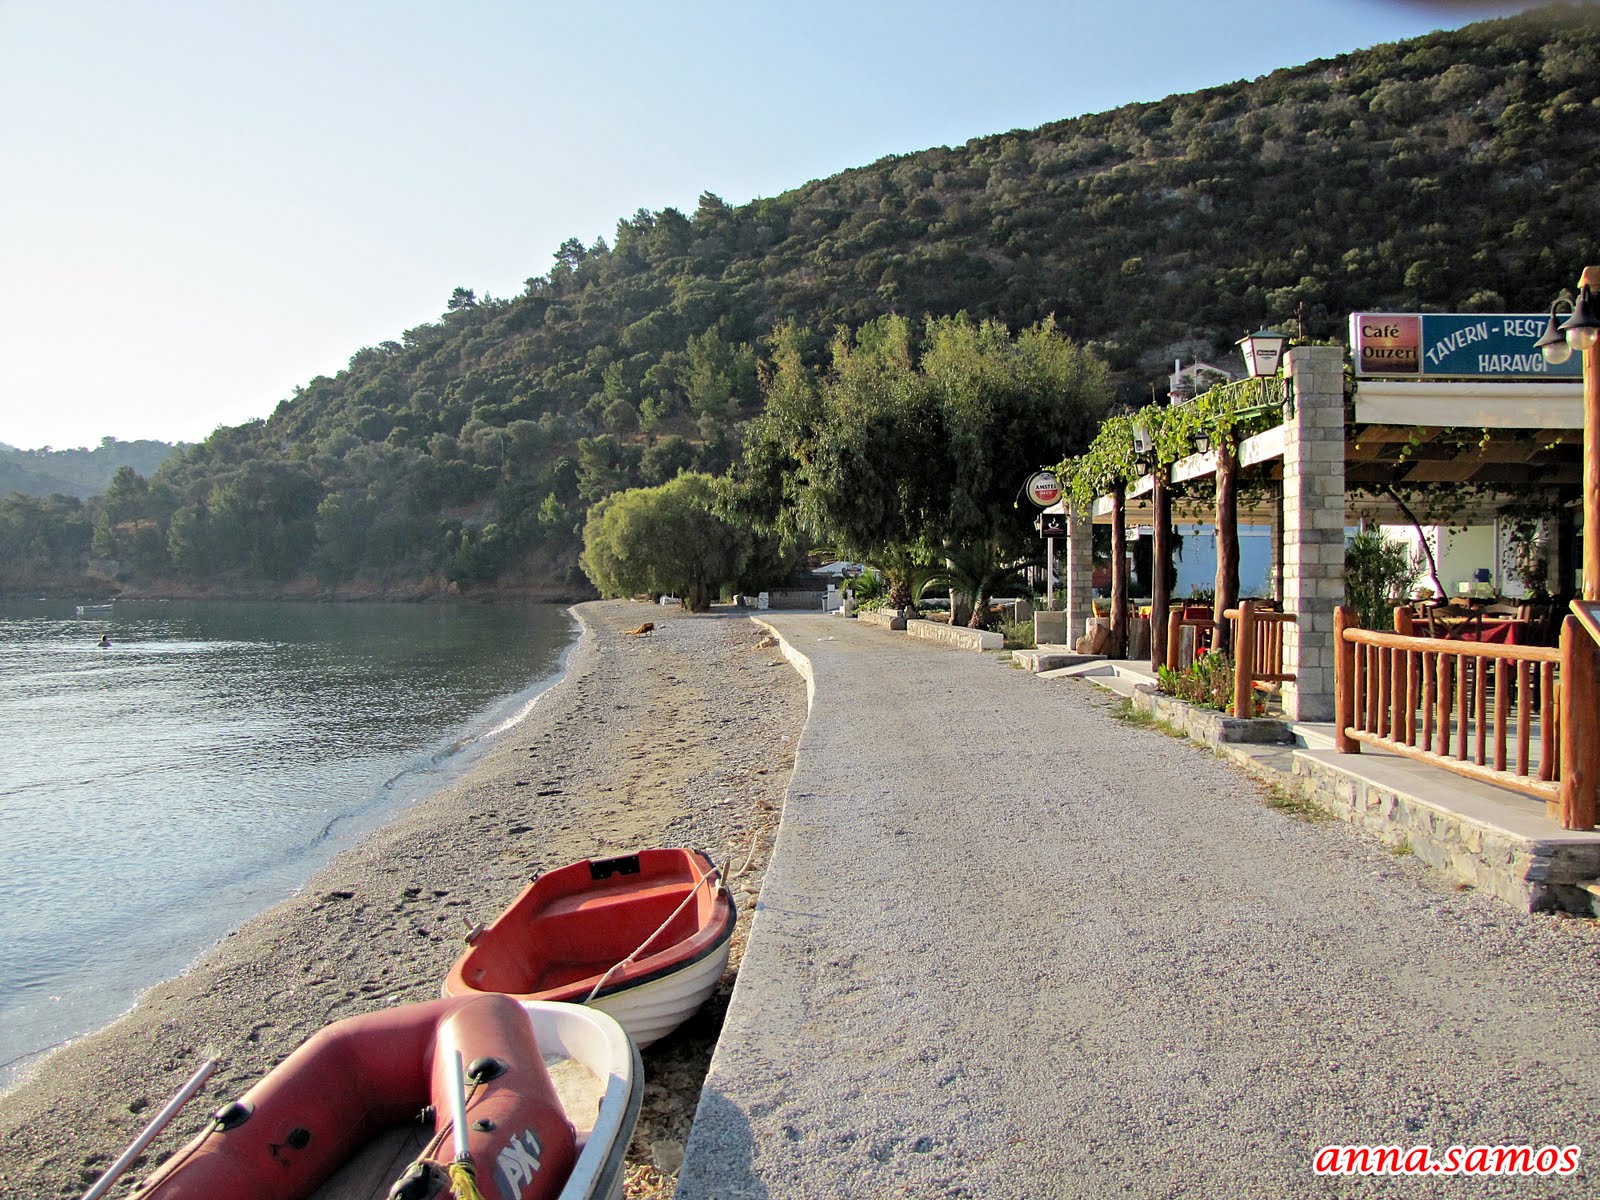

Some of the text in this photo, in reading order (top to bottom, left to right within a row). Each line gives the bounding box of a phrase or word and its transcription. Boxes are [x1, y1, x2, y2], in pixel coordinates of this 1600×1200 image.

[1362, 324, 1400, 338] Café
[1426, 321, 1488, 365] TAVERN
[1363, 346, 1417, 359] Ouzeri
